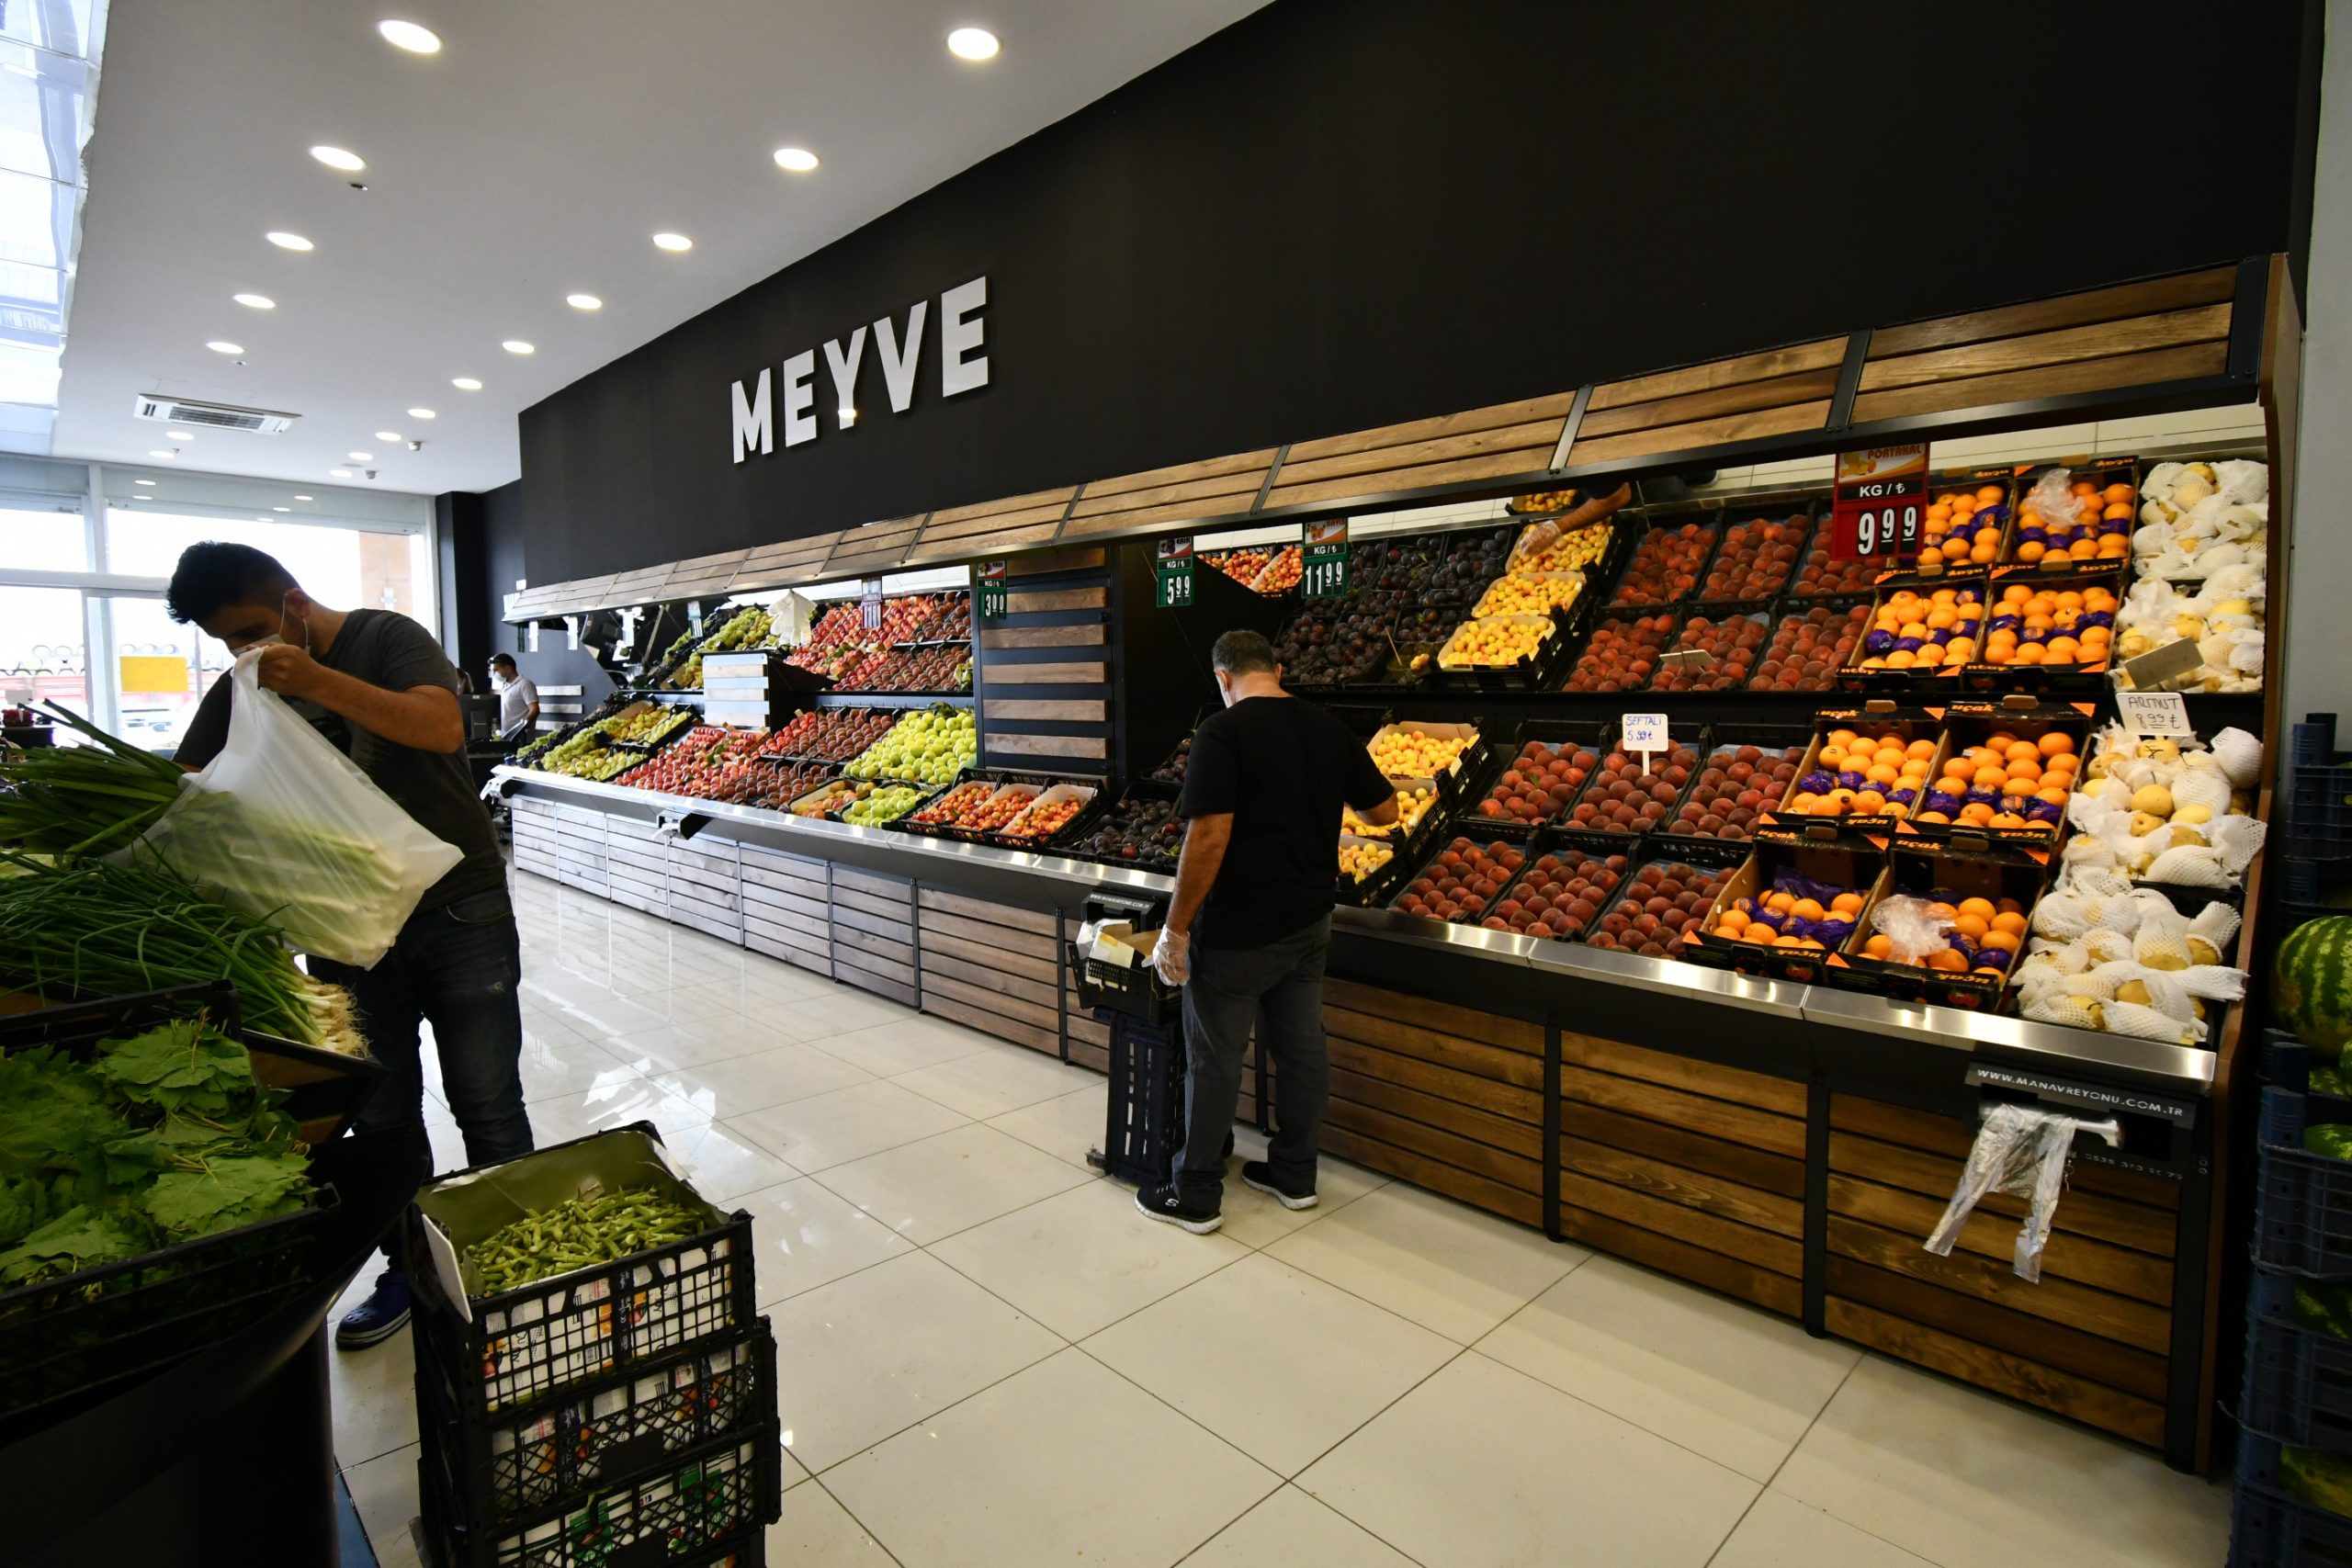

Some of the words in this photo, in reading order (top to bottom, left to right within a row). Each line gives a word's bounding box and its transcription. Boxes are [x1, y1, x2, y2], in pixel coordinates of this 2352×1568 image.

[731, 275, 989, 464] MEYVE
[1868, 444, 1922, 459] PORTAKAL
[1859, 484, 1883, 497] KG
